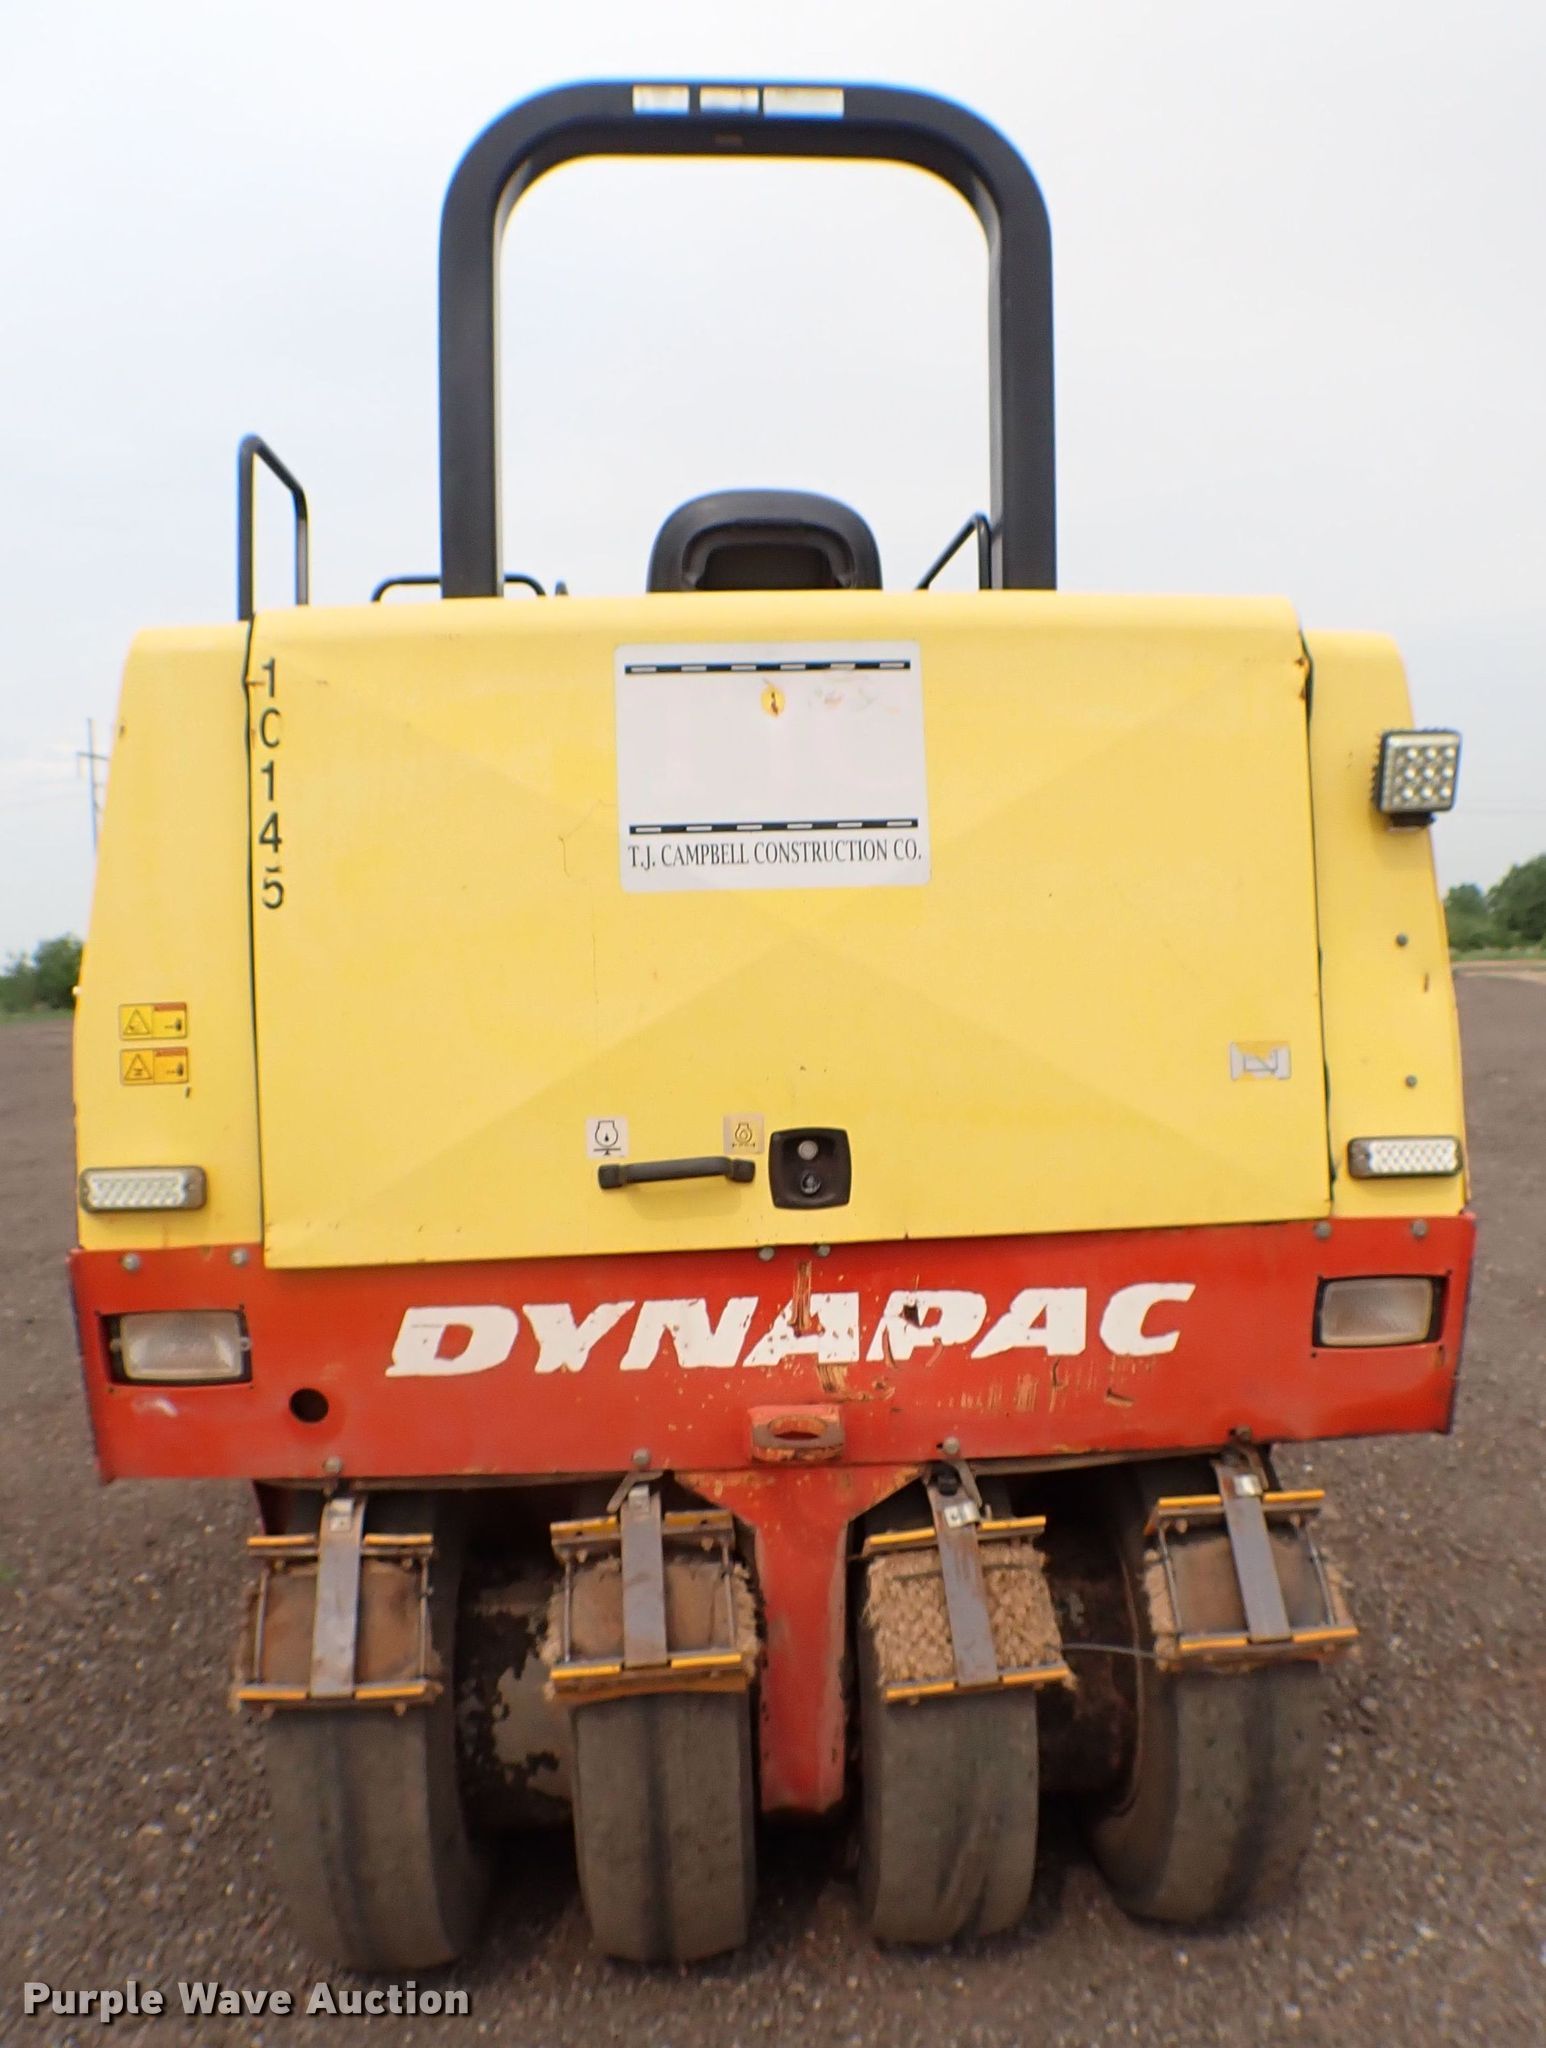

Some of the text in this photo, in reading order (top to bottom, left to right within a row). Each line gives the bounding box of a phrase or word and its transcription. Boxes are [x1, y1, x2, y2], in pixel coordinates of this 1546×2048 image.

[628, 837, 923, 871] T.J. CAMPBELL CONSTRUCTION CO.
[385, 1282, 1197, 1378] DYNAPAC
